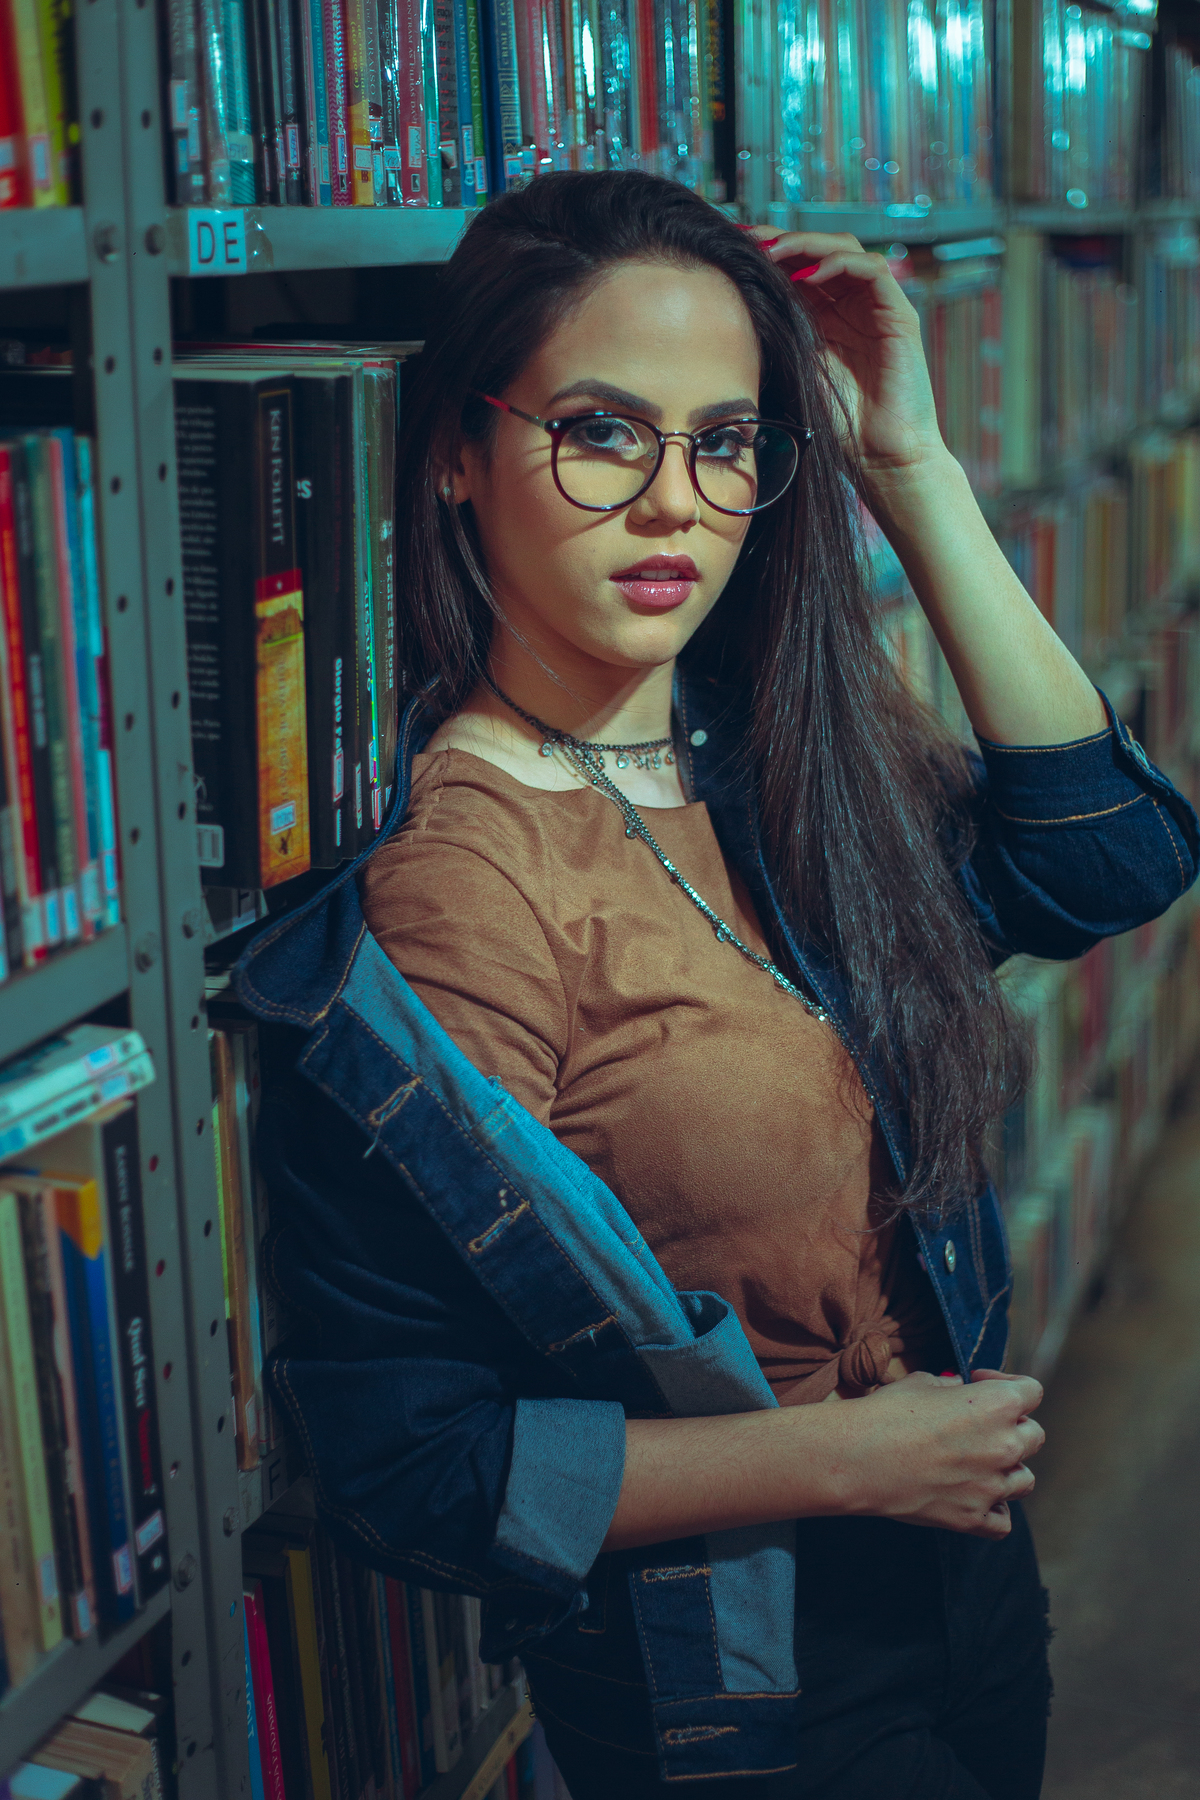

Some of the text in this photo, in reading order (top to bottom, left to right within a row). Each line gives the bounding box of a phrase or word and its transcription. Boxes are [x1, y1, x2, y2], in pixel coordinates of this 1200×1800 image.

[283, 25, 293, 83] SYLVIA
[315, 36, 323, 68] meus
[352, 50, 360, 89] agora)
[367, 27, 376, 95] PARAÍSO
[468, 6, 480, 97] ENCANTOS
[286, 93, 294, 124] DAY
[316, 73, 324, 93] dos
[198, 221, 240, 264] DE
[269, 409, 286, 545] KEN FOLLETT
[334, 657, 342, 723] Giorgio
[268, 1457, 282, 1501] F
[266, 1694, 278, 1764] PADARIA
